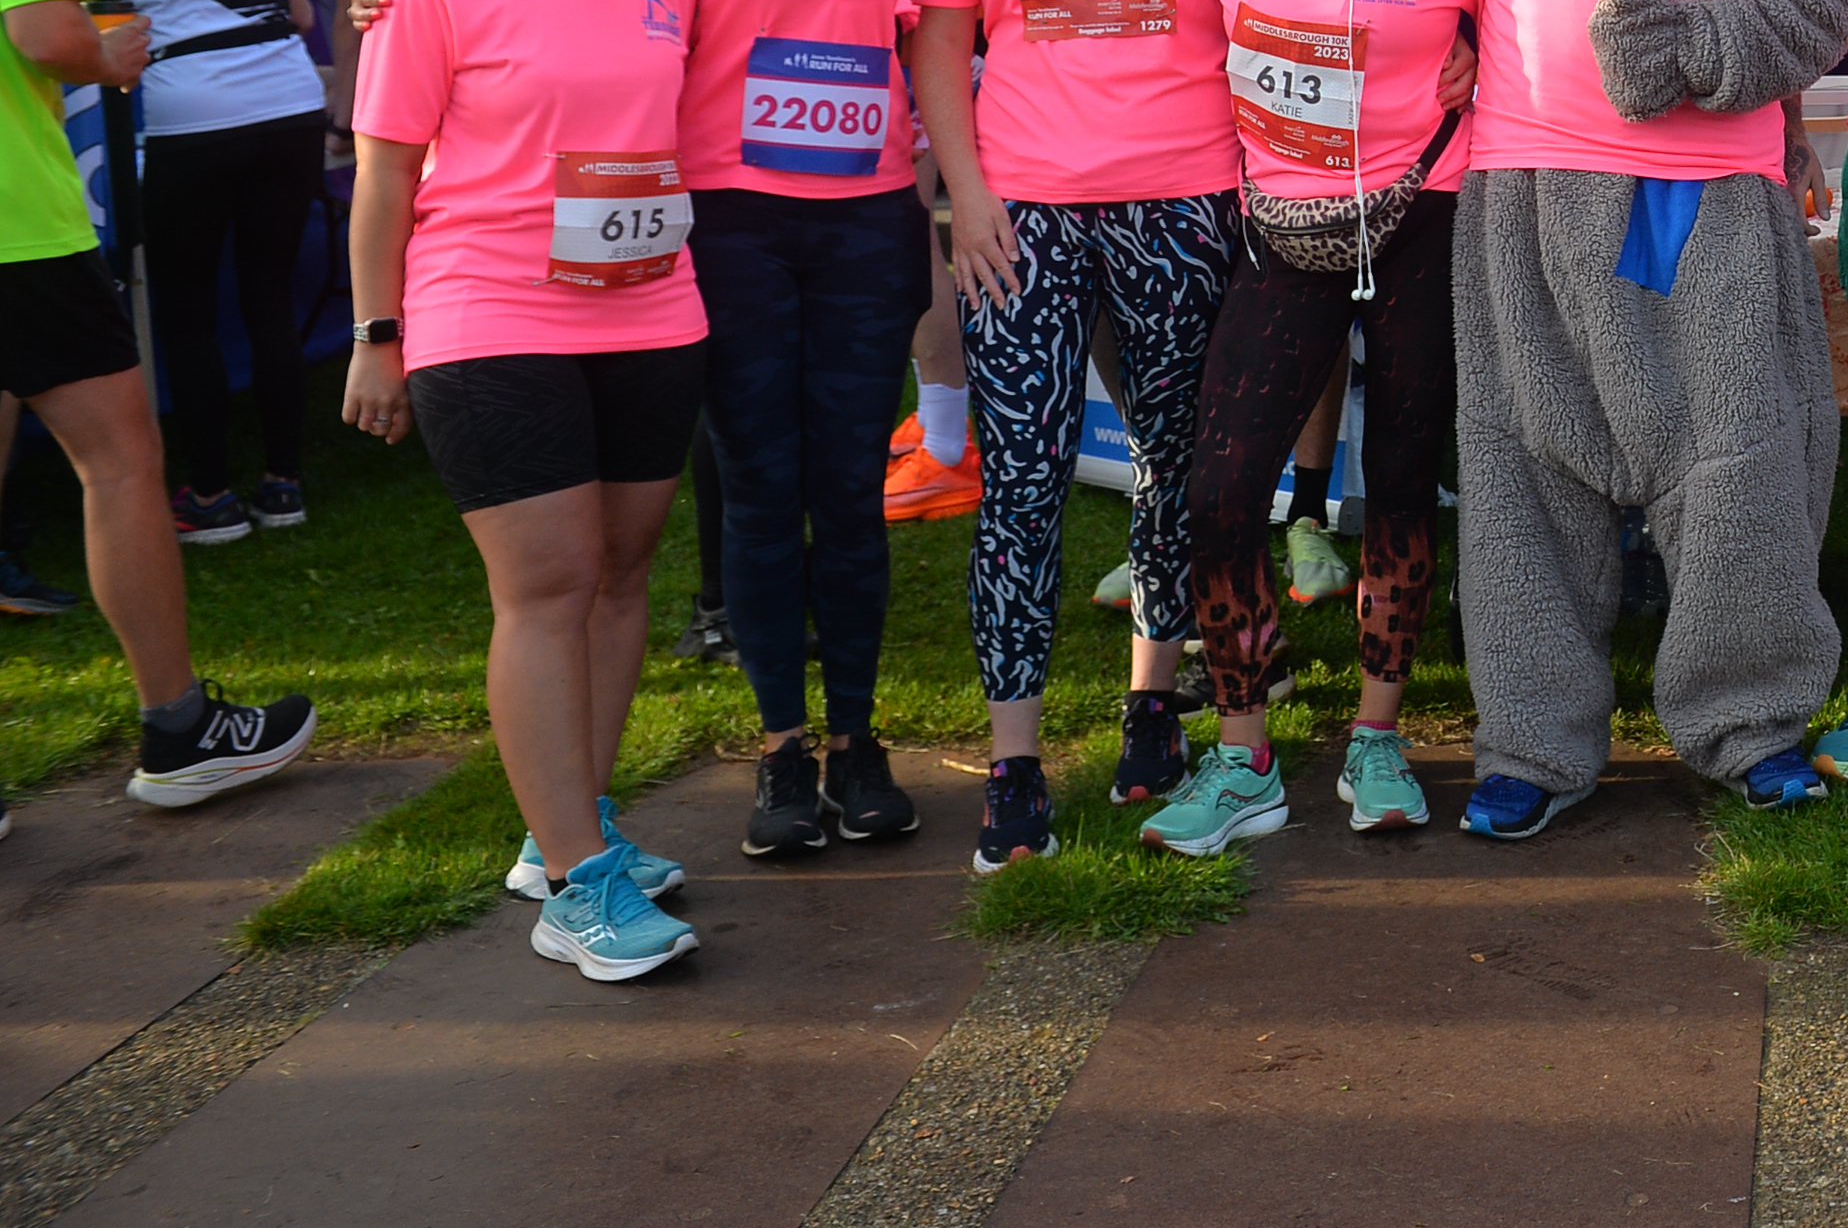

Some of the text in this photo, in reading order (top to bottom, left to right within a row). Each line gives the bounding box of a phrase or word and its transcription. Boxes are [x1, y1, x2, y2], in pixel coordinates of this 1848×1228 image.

[1058, 10, 1072, 18] ALL
[1140, 19, 1171, 31] 1279
[1253, 21, 1348, 46] MIDDLESBROUGH 10K
[1313, 45, 1349, 61] 2023
[809, 59, 869, 73] RUN FOR ALL
[1256, 65, 1322, 104] 613
[751, 93, 883, 136] 22080
[1271, 101, 1303, 119] KATIE
[1325, 155, 1350, 168] 613
[600, 207, 665, 242] 615
